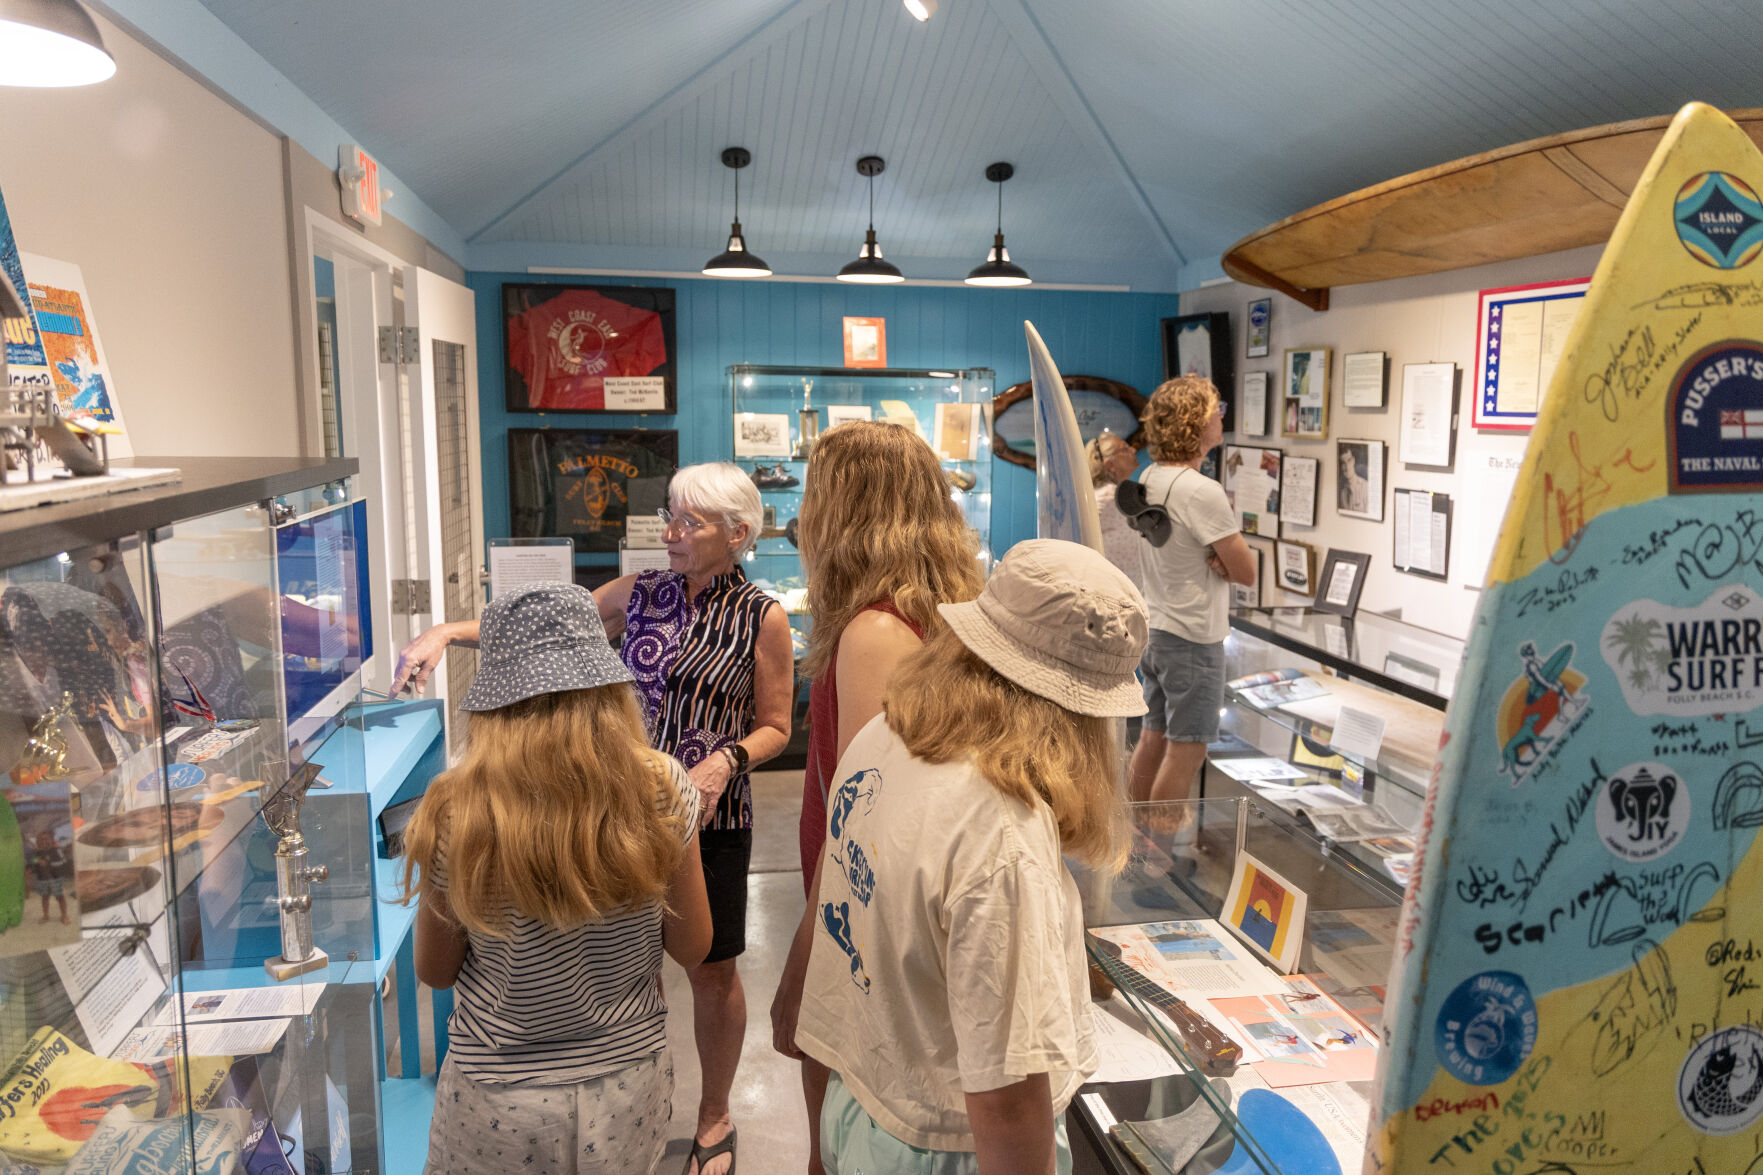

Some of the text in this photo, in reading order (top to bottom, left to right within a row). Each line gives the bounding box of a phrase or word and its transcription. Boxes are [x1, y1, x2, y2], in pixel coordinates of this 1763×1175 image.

[1699, 212, 1743, 224] ISLAND
[547, 310, 618, 339] WEST COAST EAS
[587, 358, 608, 375] CLUB
[1681, 356, 1763, 427] PUSSER'S
[557, 455, 639, 479] PALMETTO
[1681, 455, 1760, 472] THE NAVAL
[611, 482, 627, 503] CLUB
[1666, 619, 1763, 659] WARR
[1667, 658, 1745, 692] SURF
[1668, 695, 1697, 704] FOLLY
[1700, 692, 1733, 702] BEACH
[1477, 976, 1515, 998] Wind
[21, 1036, 71, 1080] Healing
[1444, 1020, 1484, 1082] Brewing
[1429, 1113, 1500, 1168] The
[1545, 1129, 1619, 1159] Cooper
